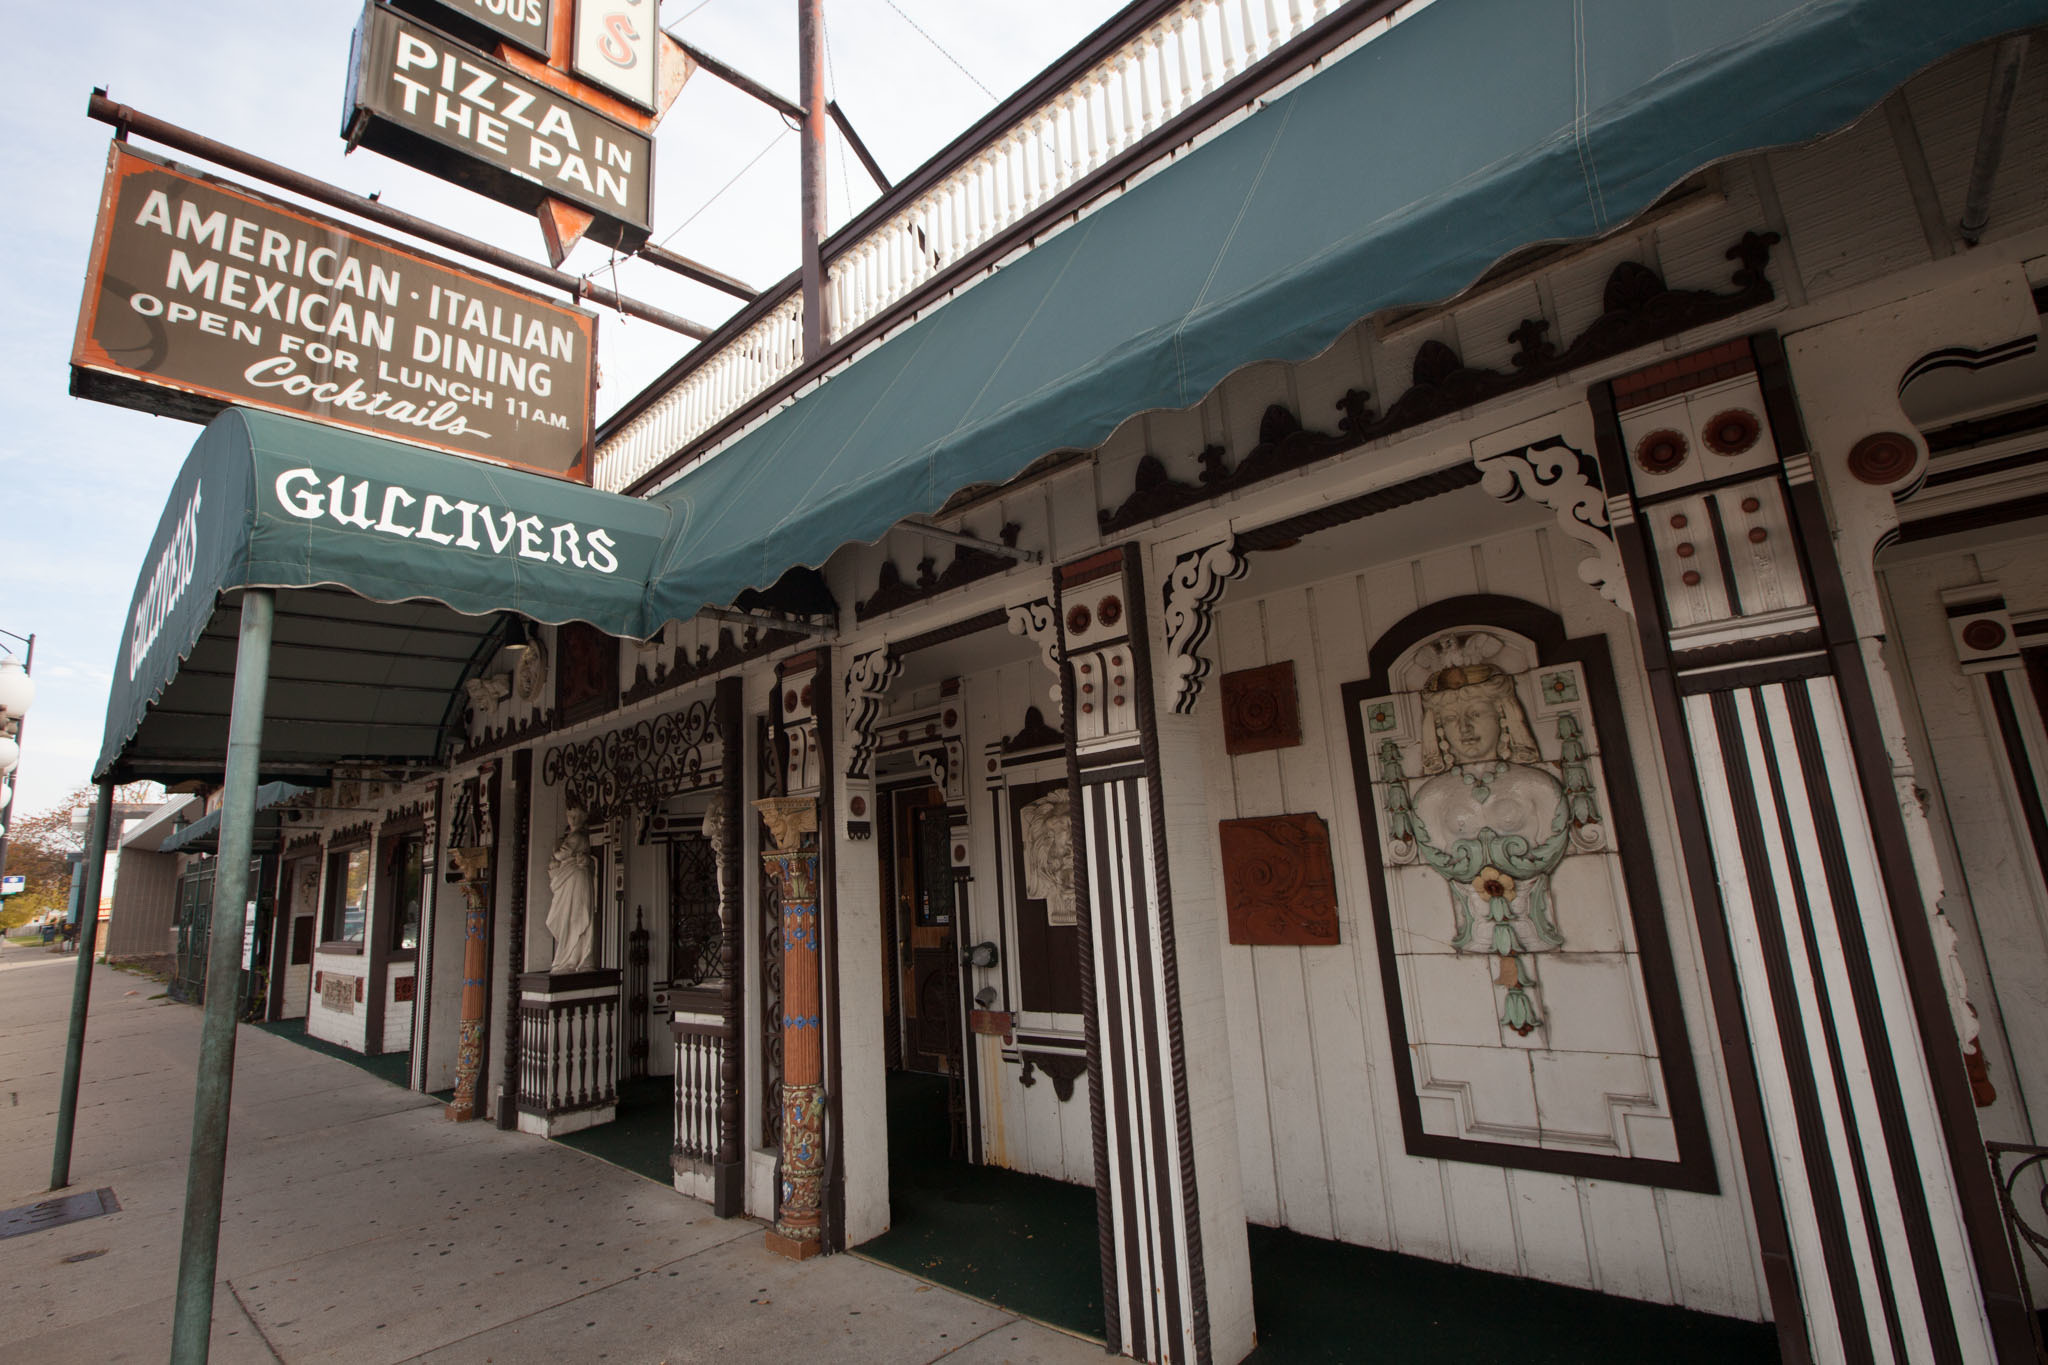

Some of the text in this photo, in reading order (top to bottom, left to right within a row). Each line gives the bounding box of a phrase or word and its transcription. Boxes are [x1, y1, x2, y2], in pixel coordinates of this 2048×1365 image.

[393, 73, 628, 207] THE PAN
[396, 31, 632, 174] PIZZA IN
[135, 190, 574, 364] AMERICAN ITALIAN
[166, 249, 552, 398] MEXICAN DINING
[130, 293, 570, 431] OPEN FOR LUNCH 11 A.M.
[244, 356, 492, 439] Cocktails
[130, 478, 202, 682] GULLIVERS
[275, 467, 619, 574] GULLIVERS
